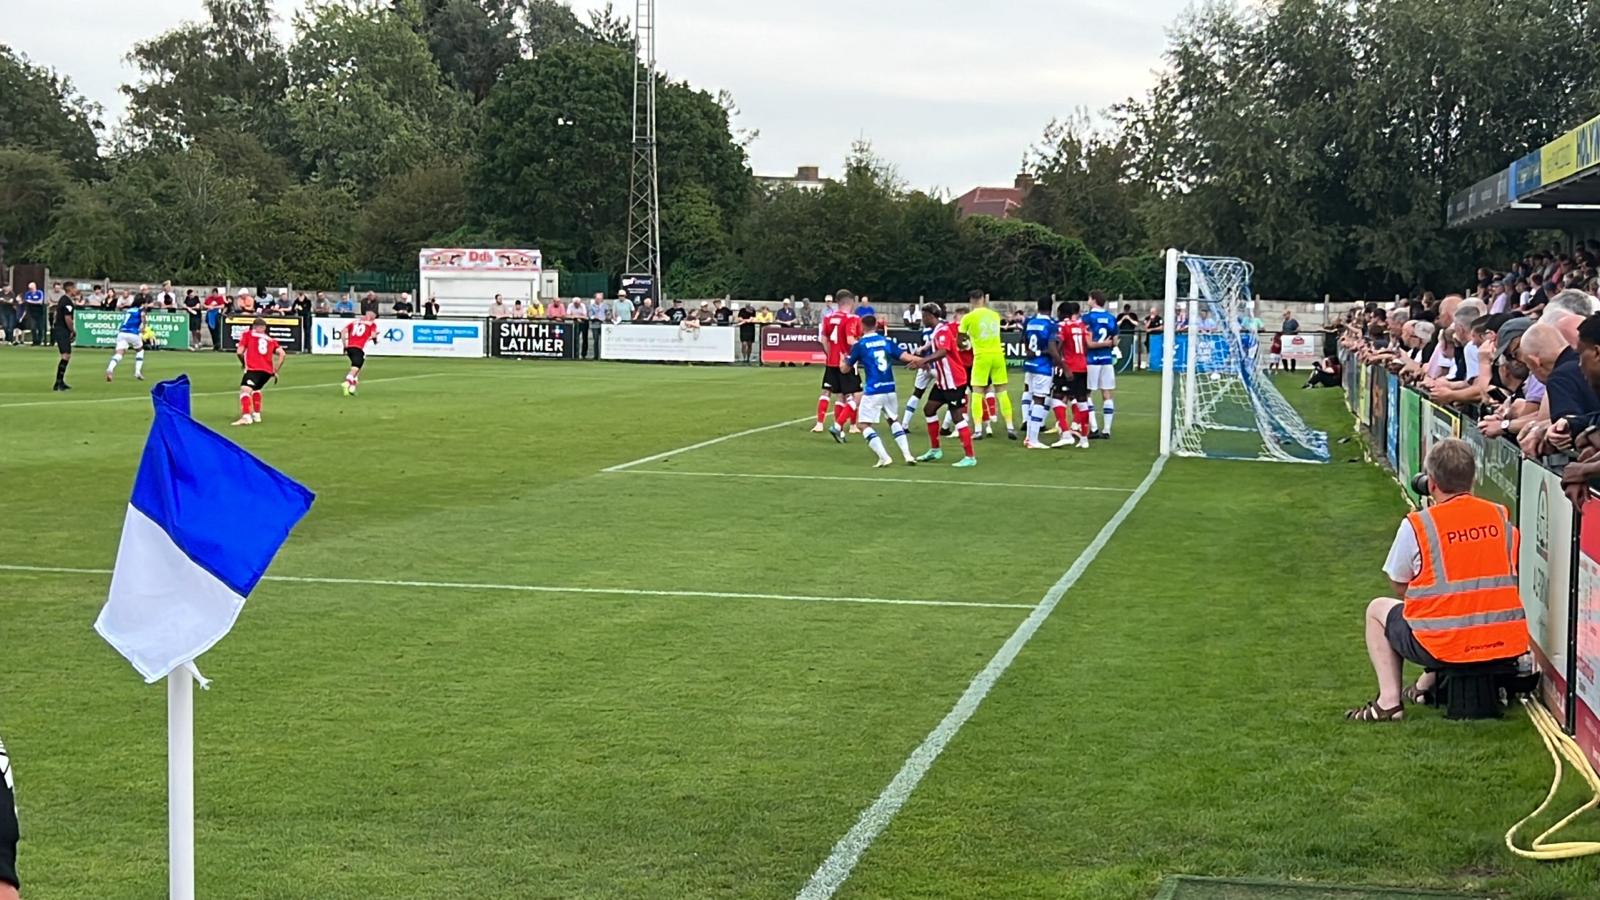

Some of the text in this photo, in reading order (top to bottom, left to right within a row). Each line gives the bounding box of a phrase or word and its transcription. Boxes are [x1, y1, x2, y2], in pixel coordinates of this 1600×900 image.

[351, 322, 366, 337] 10
[383, 327, 405, 342] 40
[500, 323, 549, 338] SMITH
[780, 334, 818, 342] LAWRENC
[829, 325, 838, 344] 4
[1097, 327, 1108, 344] 2
[258, 337, 268, 355] 8
[499, 338, 564, 352] LATIMER
[1028, 334, 1038, 352] 8
[1072, 335, 1083, 354] 11
[873, 350, 888, 372] 3
[1447, 524, 1499, 544] PHOTO
